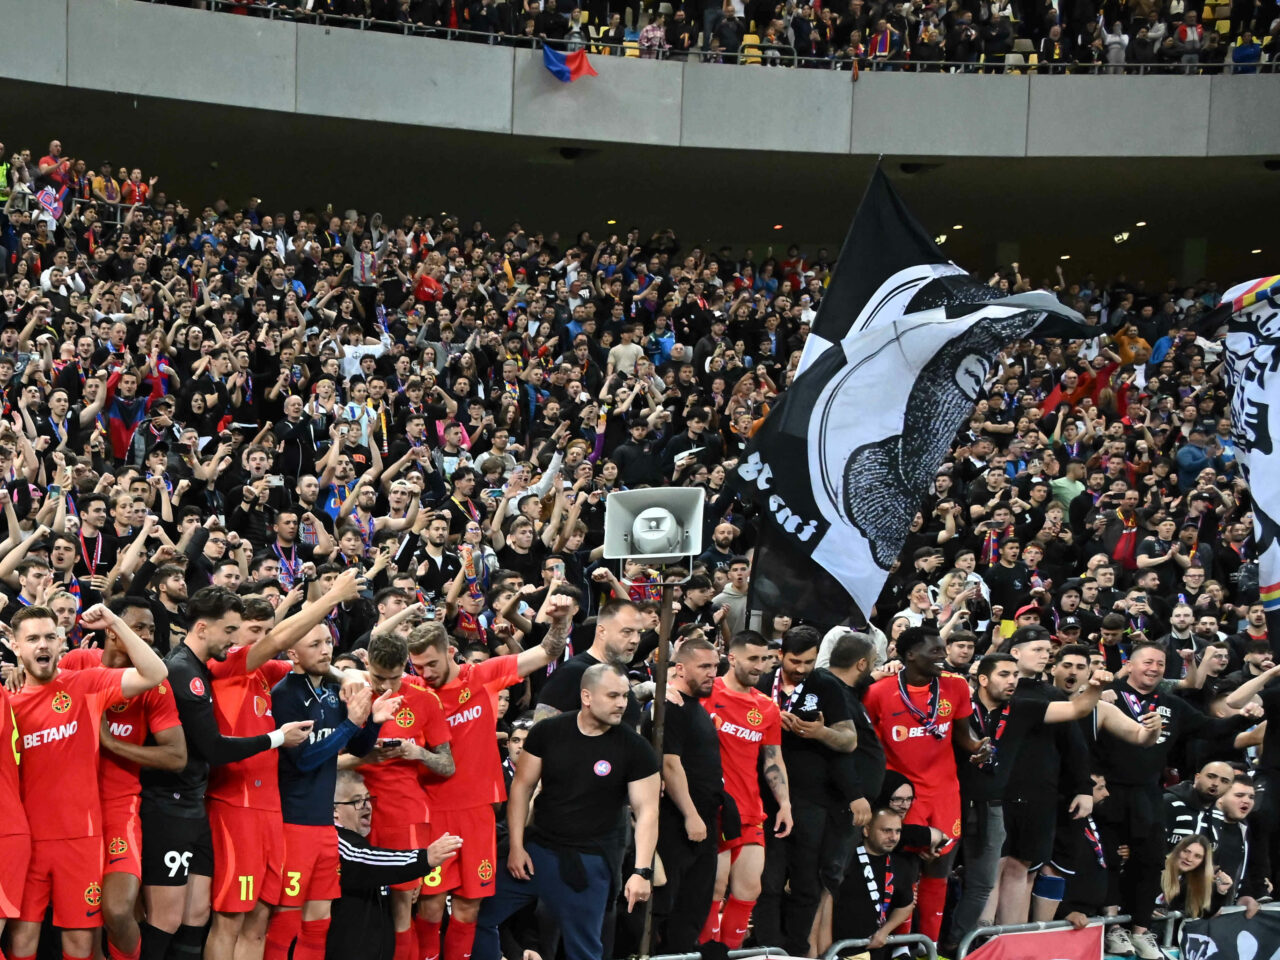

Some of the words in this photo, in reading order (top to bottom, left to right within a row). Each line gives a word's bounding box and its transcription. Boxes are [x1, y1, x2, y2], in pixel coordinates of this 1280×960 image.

[445, 705, 482, 728] TANO
[23, 720, 78, 749] BETANO
[720, 721, 763, 742] BETANO
[238, 876, 254, 900] 11
[285, 871, 301, 897] 3
